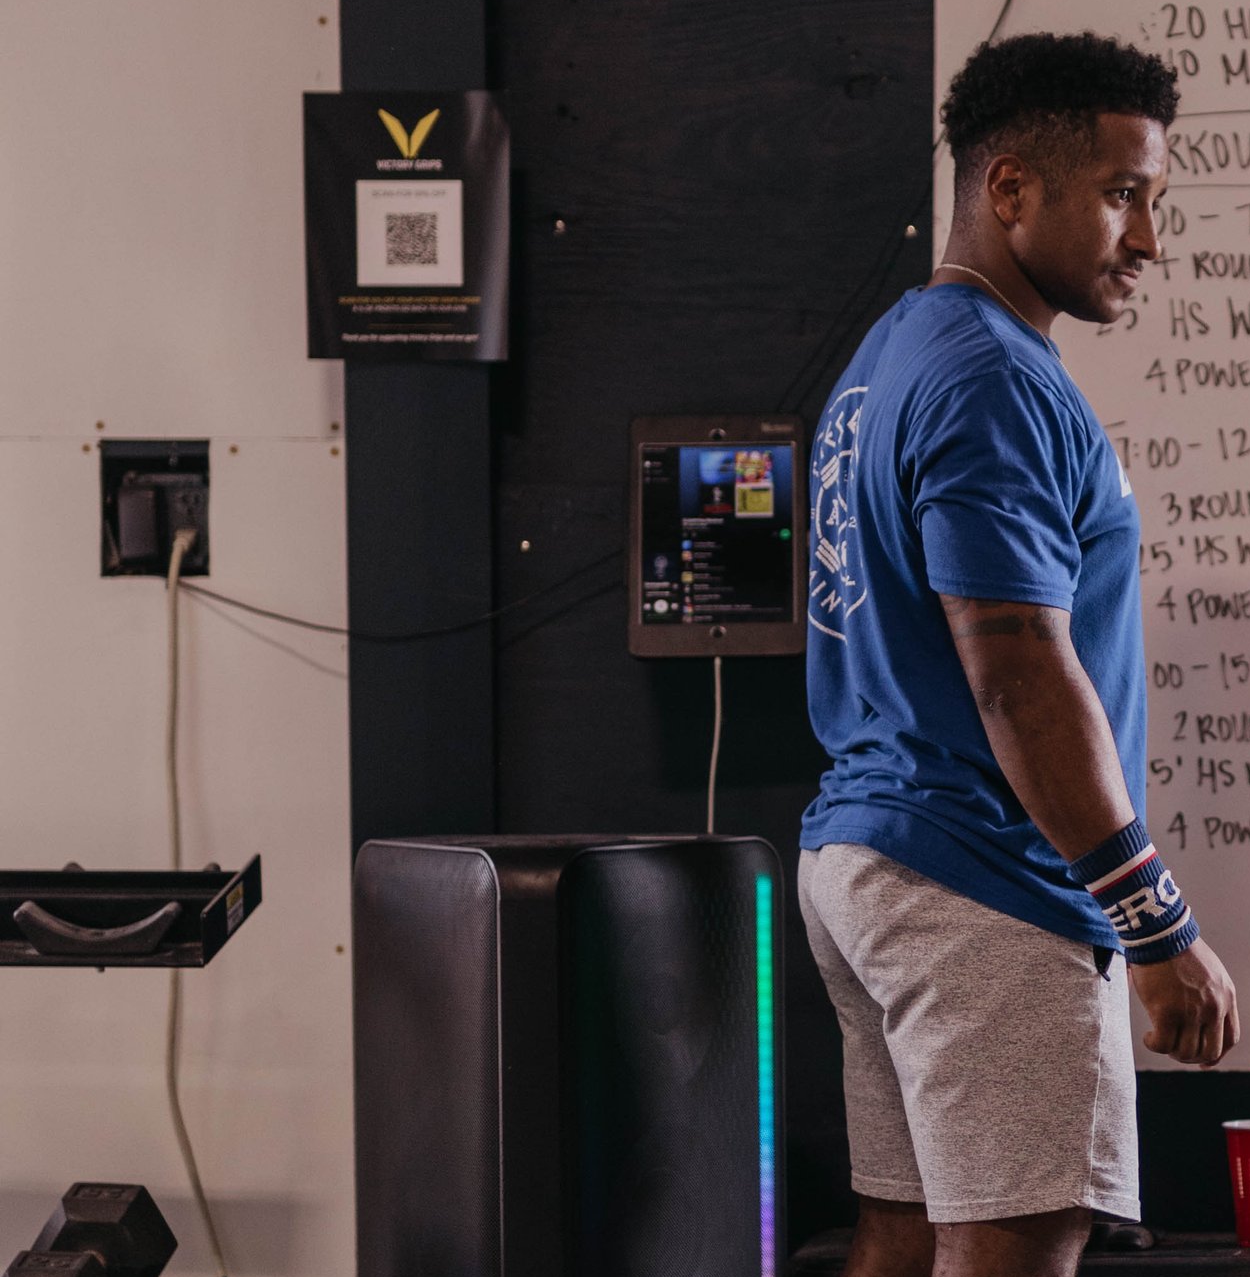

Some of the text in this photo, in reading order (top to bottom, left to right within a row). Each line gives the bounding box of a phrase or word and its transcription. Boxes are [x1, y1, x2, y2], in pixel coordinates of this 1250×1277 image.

[1169, 297, 1210, 341] HS
[1144, 358, 1168, 393] 4
[1160, 492, 1183, 525] 3
[1193, 534, 1230, 569] HS
[1156, 585, 1177, 622] 4
[1172, 710, 1189, 742] 2
[1196, 755, 1236, 795] HS
[1165, 811, 1189, 851] 4
